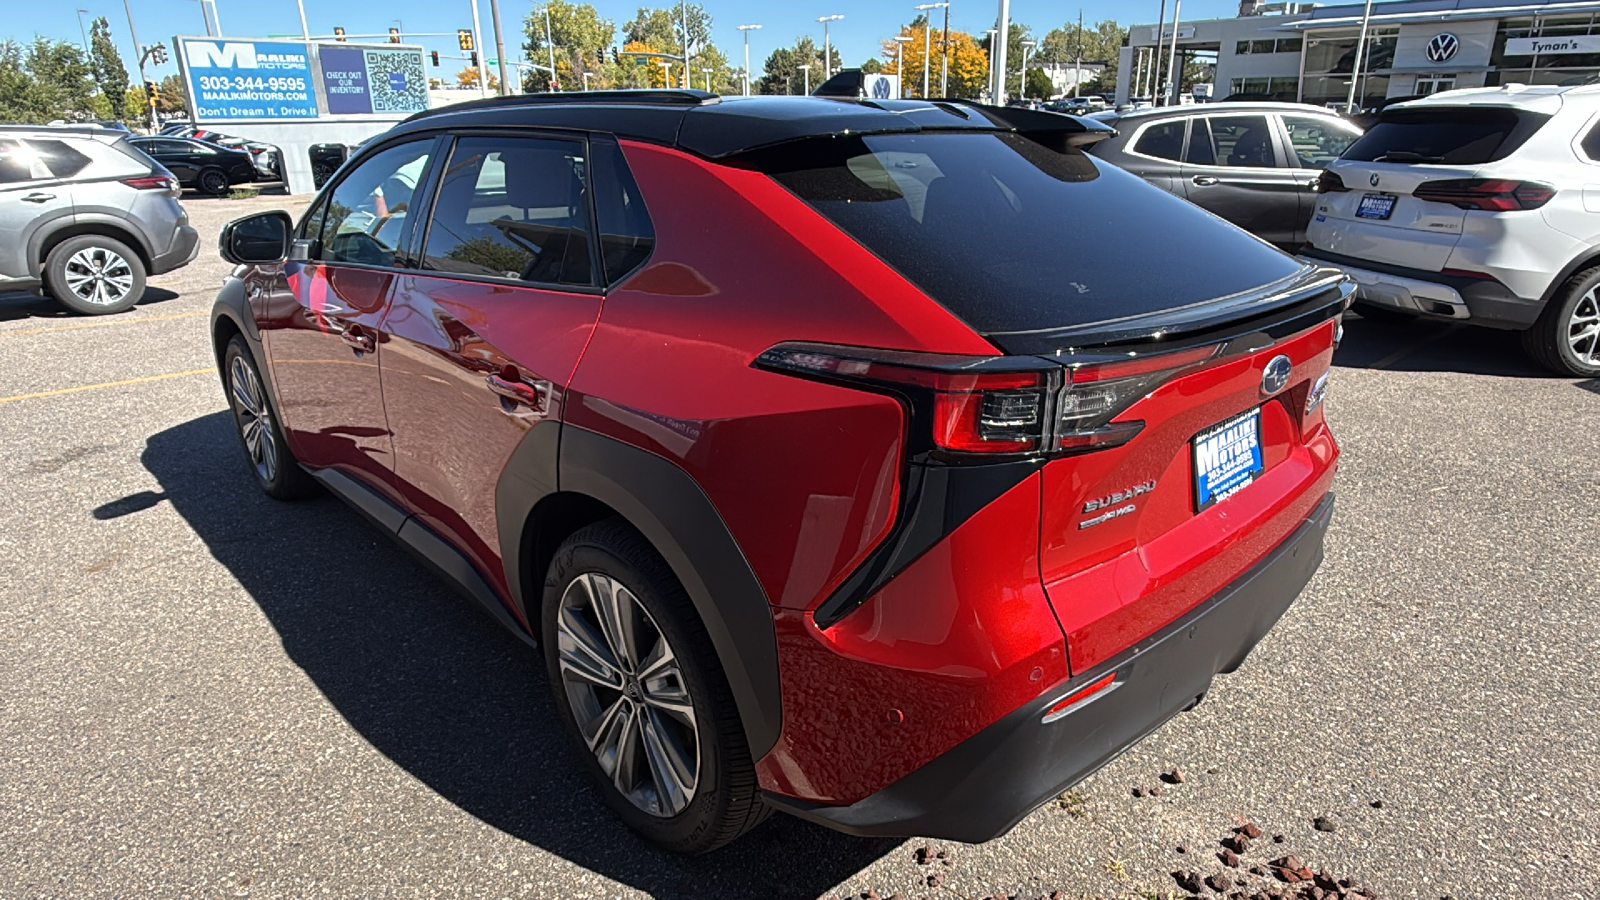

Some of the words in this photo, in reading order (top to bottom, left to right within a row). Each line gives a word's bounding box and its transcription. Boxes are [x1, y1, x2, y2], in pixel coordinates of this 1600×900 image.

[1532, 40, 1578, 52] Tynan's
[185, 41, 305, 68] MAALIKI
[348, 71, 361, 79] OUT
[200, 76, 306, 91] 303-344-9595
[203, 91, 307, 101] MAALIKIMOTORS.COM
[329, 86, 364, 94] INVENTORY
[198, 107, 226, 116] Don't
[230, 107, 264, 116] Dream
[281, 107, 307, 116] Drive
[309, 106, 316, 115] It
[1208, 449, 1253, 482] 303-344-9595
[1082, 479, 1157, 514] SUBARU
